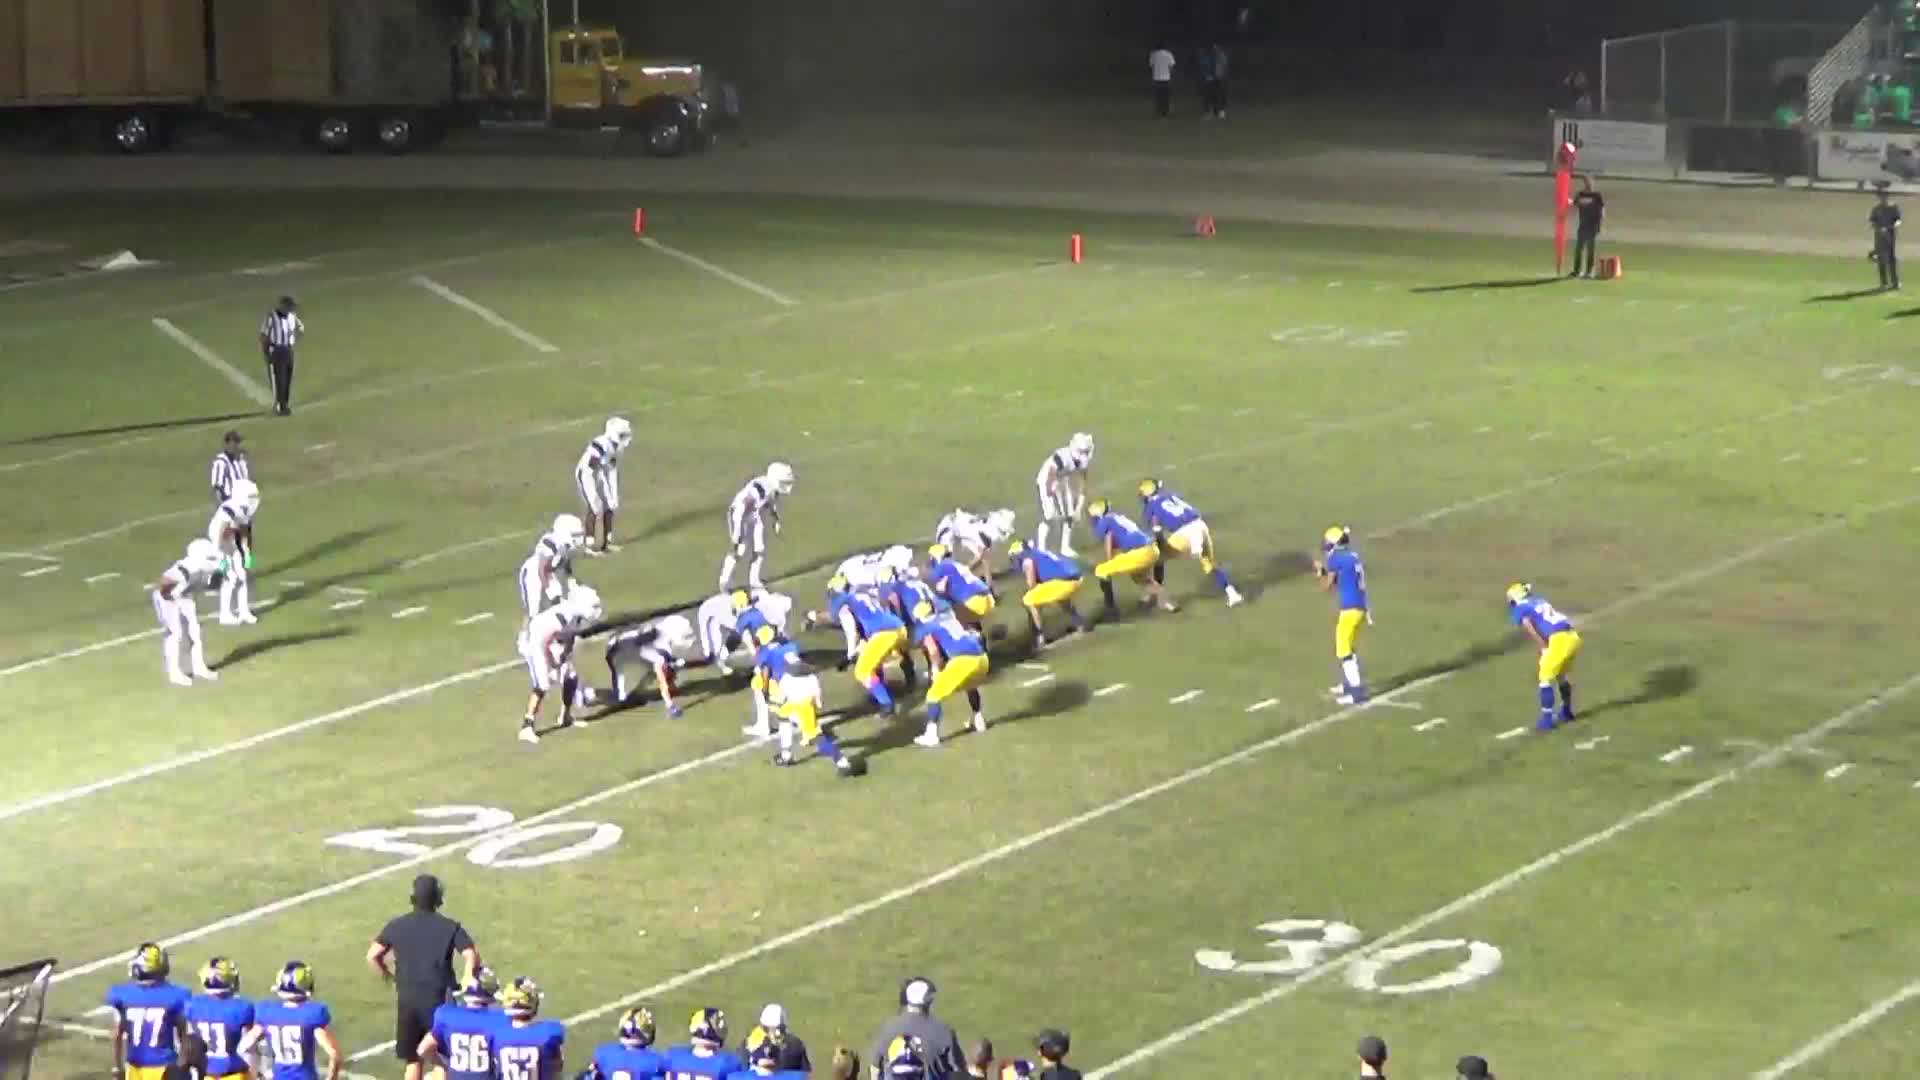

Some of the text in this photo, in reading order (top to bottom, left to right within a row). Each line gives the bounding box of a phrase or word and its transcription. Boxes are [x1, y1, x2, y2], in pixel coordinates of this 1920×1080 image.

[325, 804, 623, 868] 20
[1196, 919, 1503, 993] 30
[127, 1007, 165, 1047] 77
[450, 1033, 489, 1072] 56
